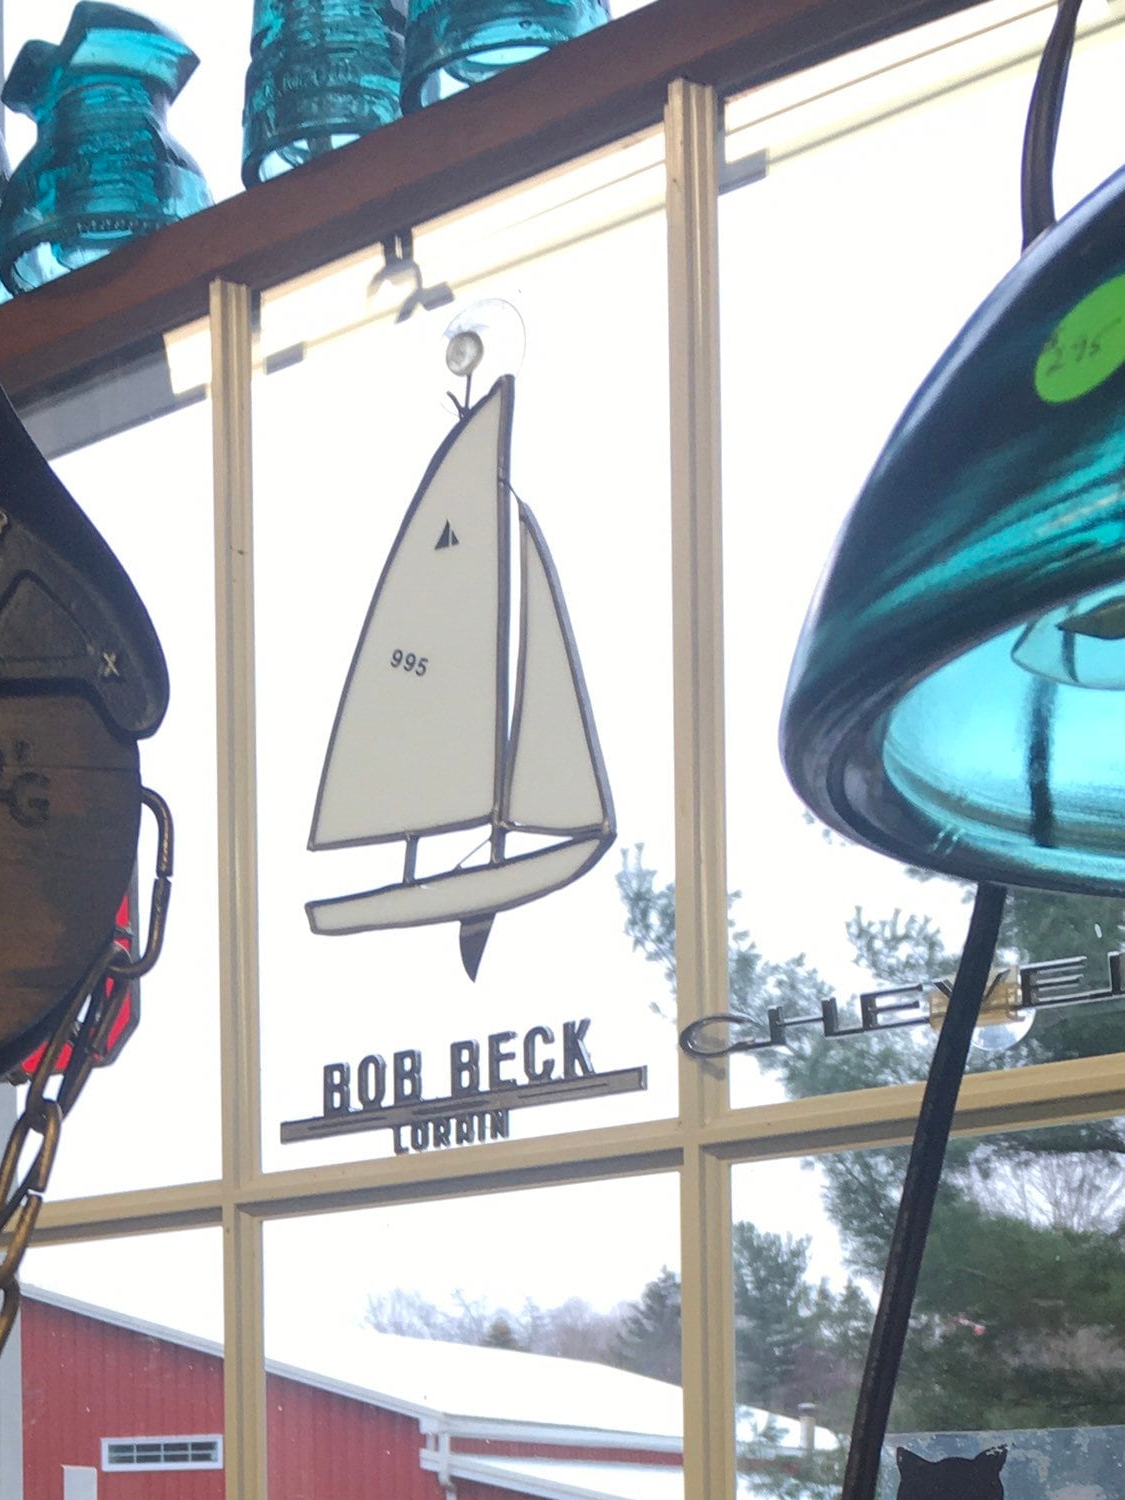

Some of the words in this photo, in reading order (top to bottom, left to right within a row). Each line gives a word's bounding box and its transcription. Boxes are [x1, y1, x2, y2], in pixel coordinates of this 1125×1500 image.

[390, 648, 429, 677] 995
[323, 1048, 424, 1119] BOB
[450, 1017, 598, 1098] BECK
